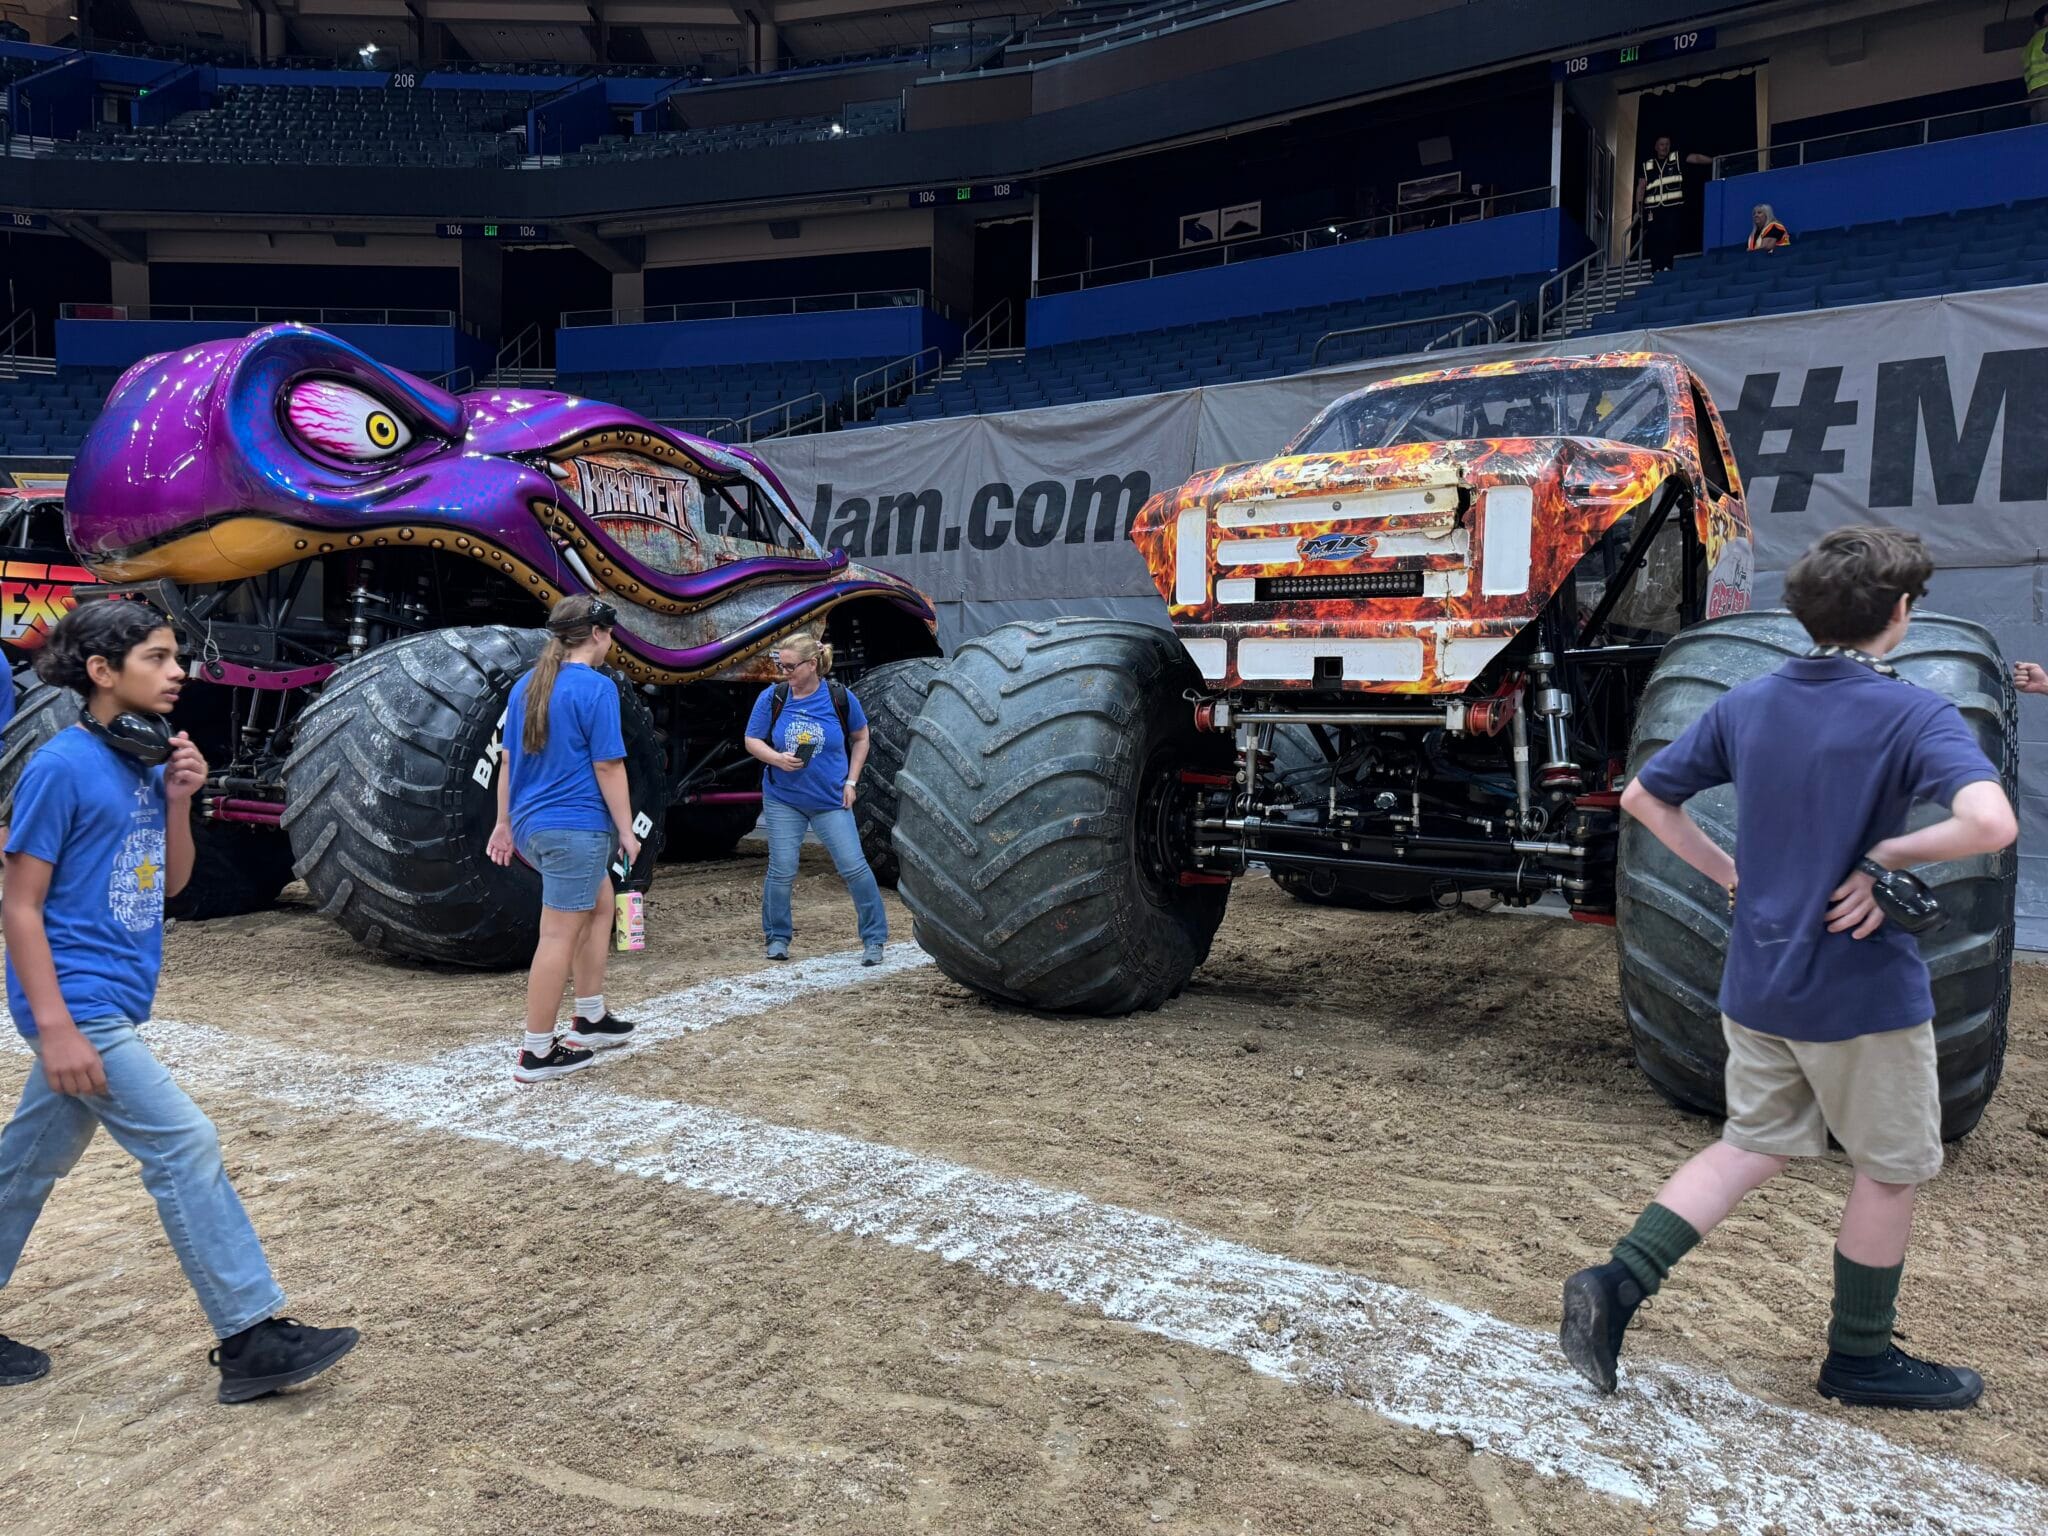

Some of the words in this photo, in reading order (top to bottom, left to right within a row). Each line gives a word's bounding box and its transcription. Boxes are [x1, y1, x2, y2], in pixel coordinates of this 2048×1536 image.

[1564, 57, 1588, 74] 108
[1620, 46, 1640, 64] EXIT
[1673, 32, 1698, 50] 109
[394, 73, 415, 88] 206
[919, 191, 936, 203] 106
[957, 187, 971, 200] EXIT
[993, 184, 1010, 196] 108
[12, 214, 32, 226] 106
[446, 224, 463, 235] 106
[484, 225, 498, 236] EXIT
[520, 226, 536, 236] 106
[574, 458, 692, 536] KRAKEN
